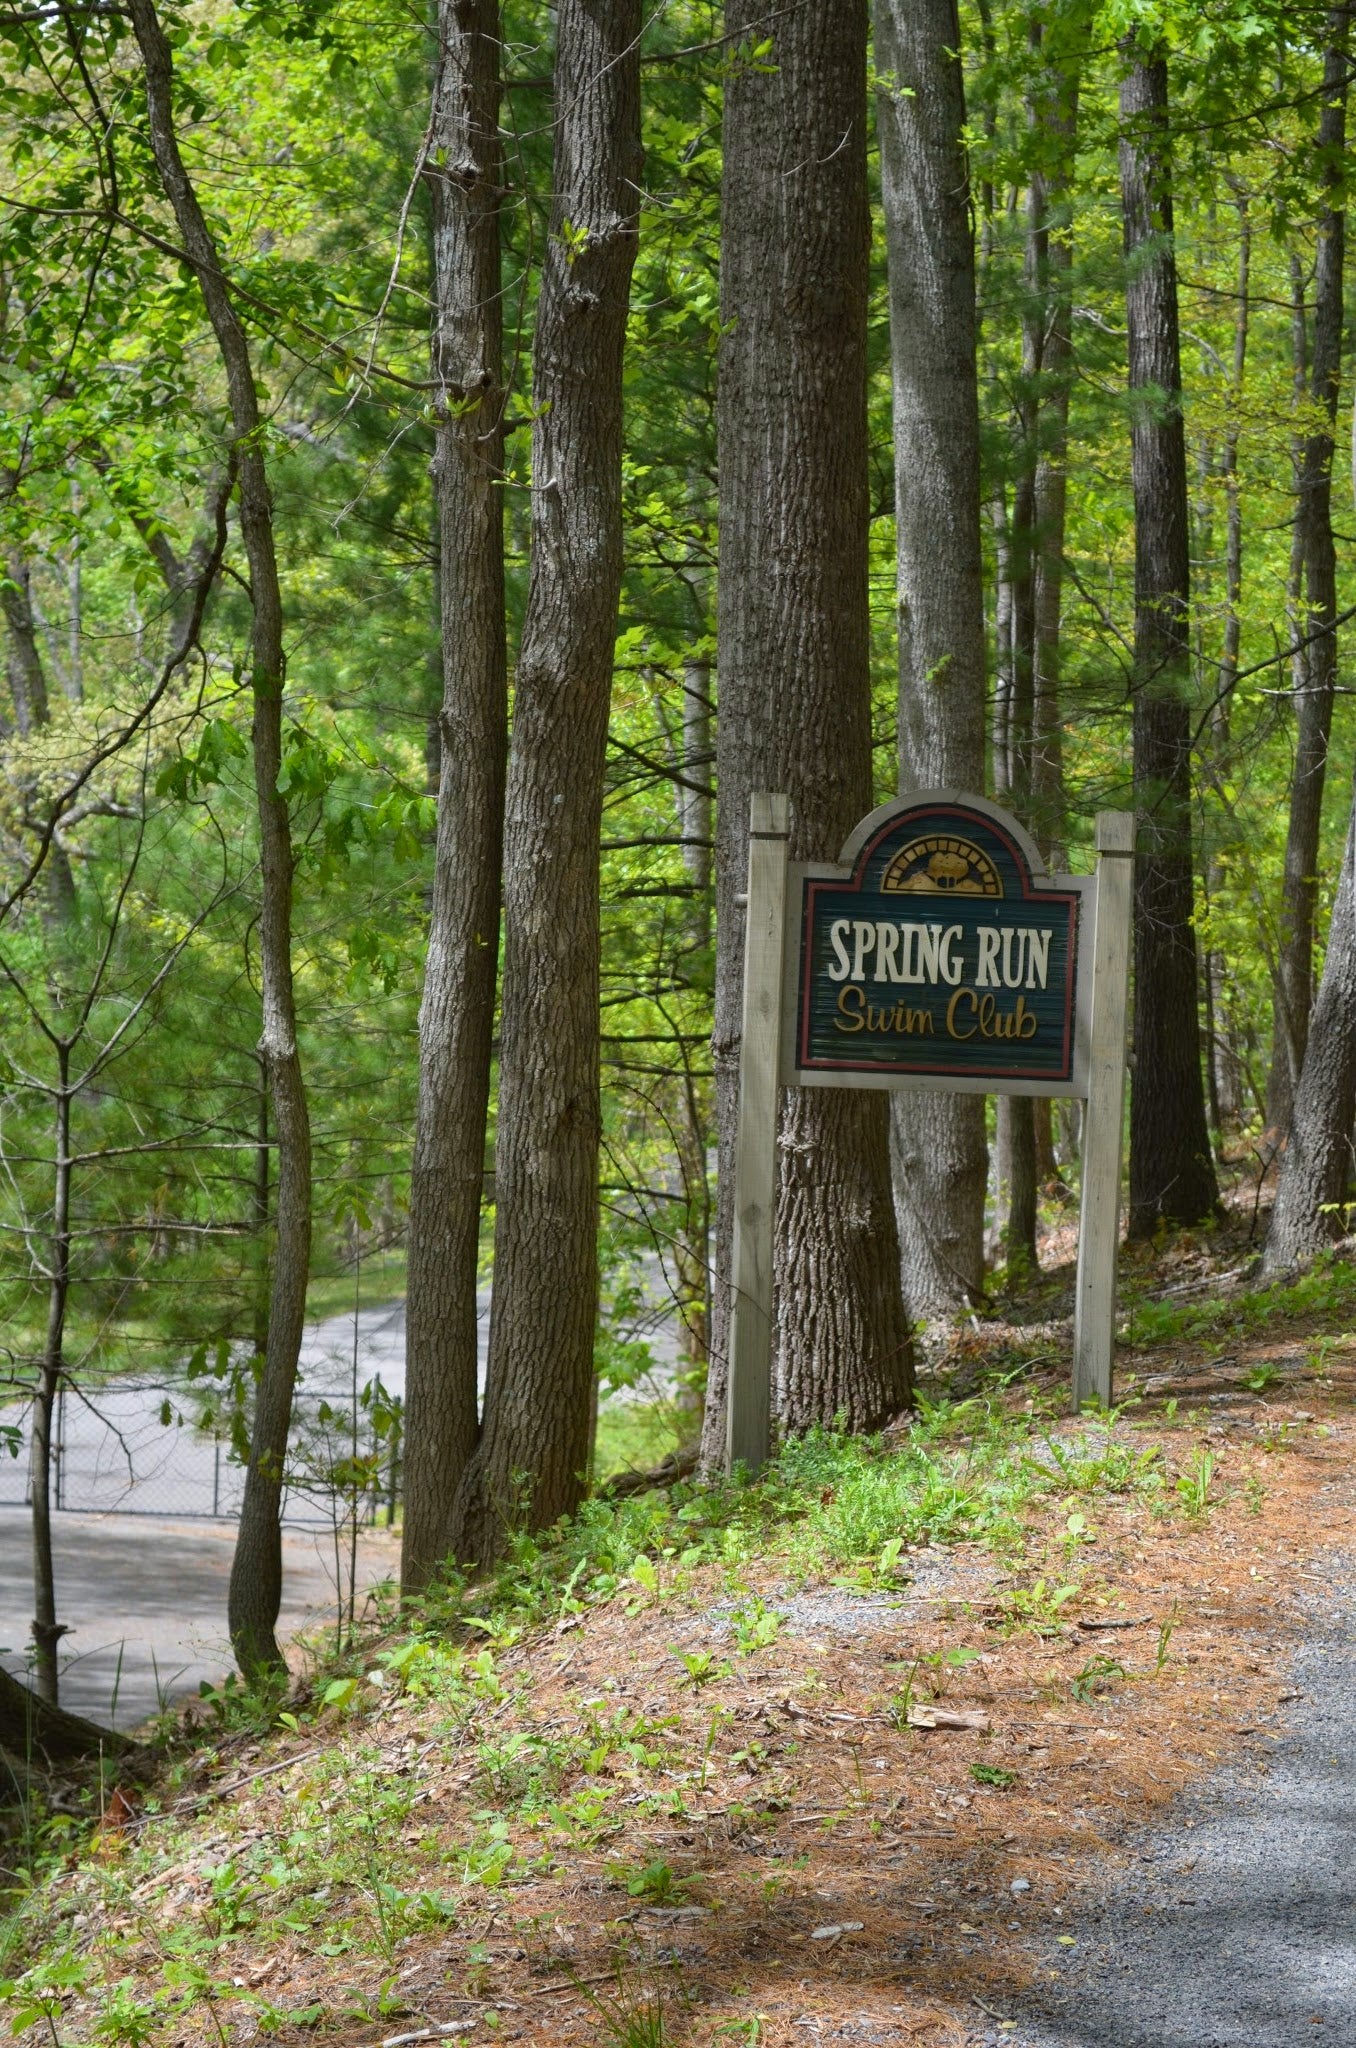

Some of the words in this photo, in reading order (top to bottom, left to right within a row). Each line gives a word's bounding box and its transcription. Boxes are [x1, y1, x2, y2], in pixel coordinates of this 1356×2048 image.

[828, 919, 964, 986] SPRING
[975, 926, 1053, 990] RUN
[833, 985, 935, 1034] Swim
[946, 987, 1038, 1040] Club
